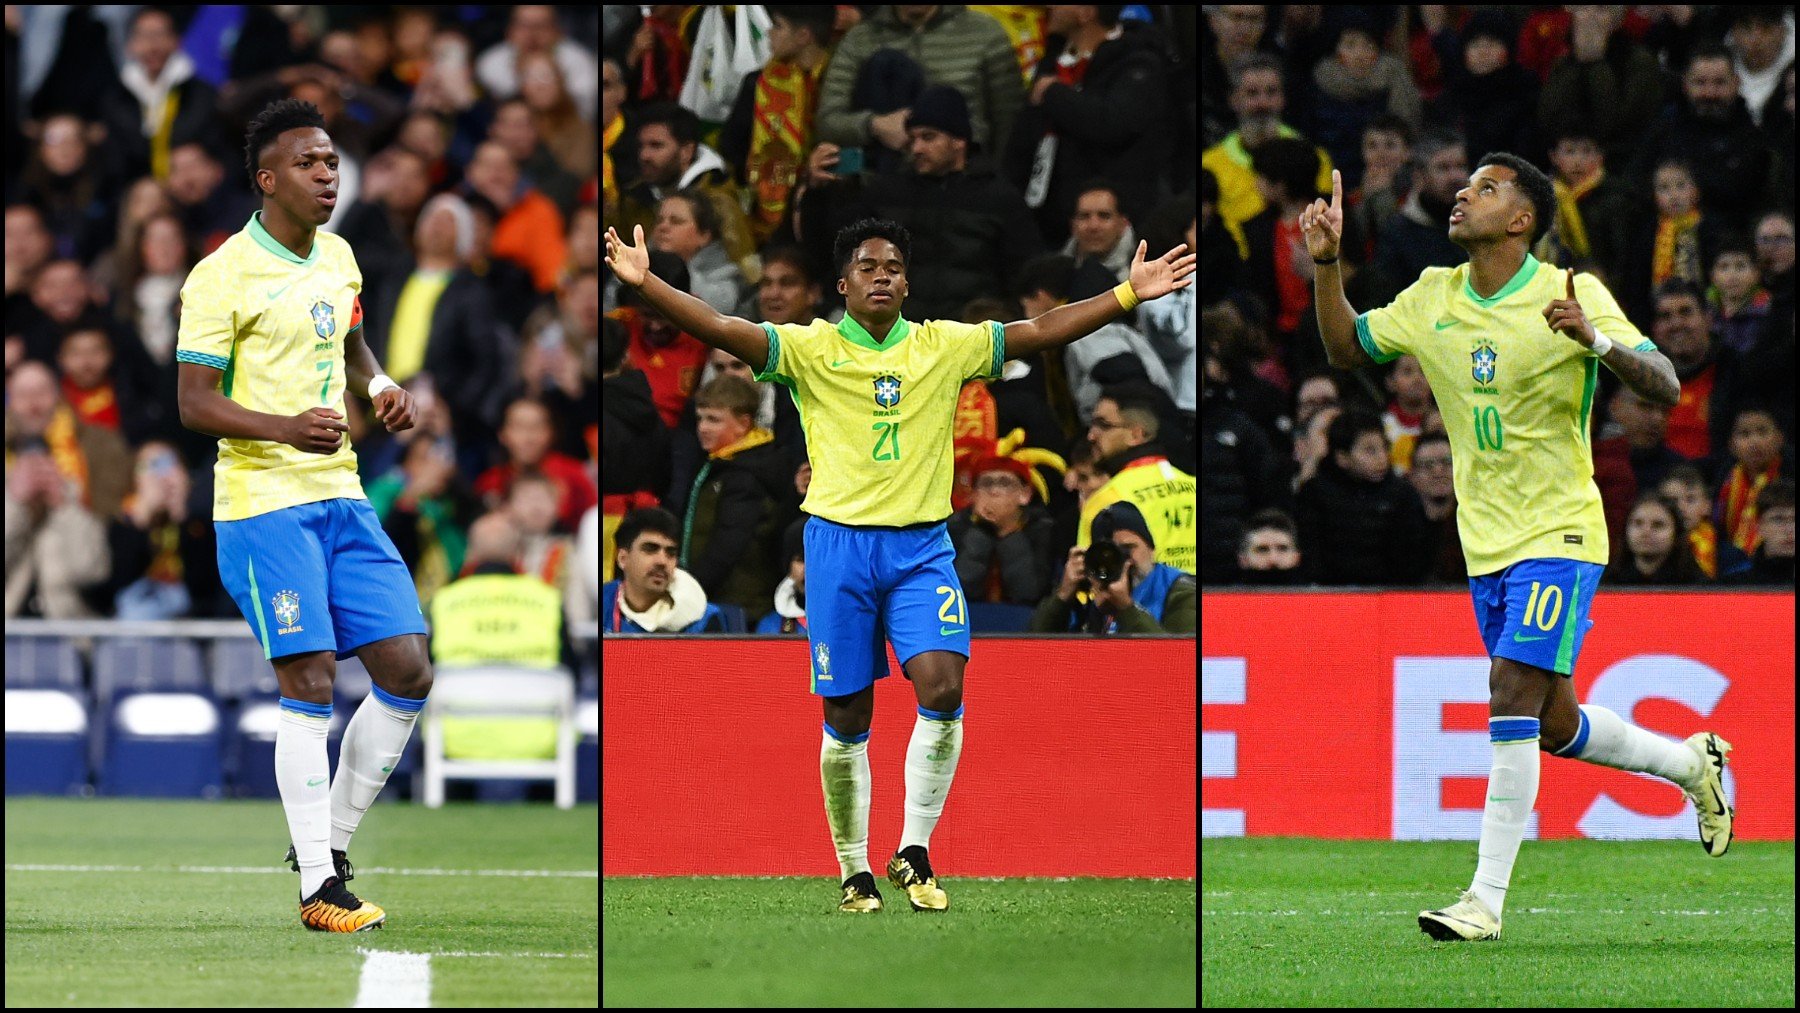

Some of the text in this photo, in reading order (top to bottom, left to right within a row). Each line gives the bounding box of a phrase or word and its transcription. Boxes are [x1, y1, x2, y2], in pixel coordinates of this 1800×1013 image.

[316, 361, 334, 405] 7
[872, 421, 900, 461] 21
[1473, 406, 1503, 451] 10
[936, 586, 965, 625] 21
[1523, 582, 1562, 631] 10
[278, 626, 304, 635] BRASIL
